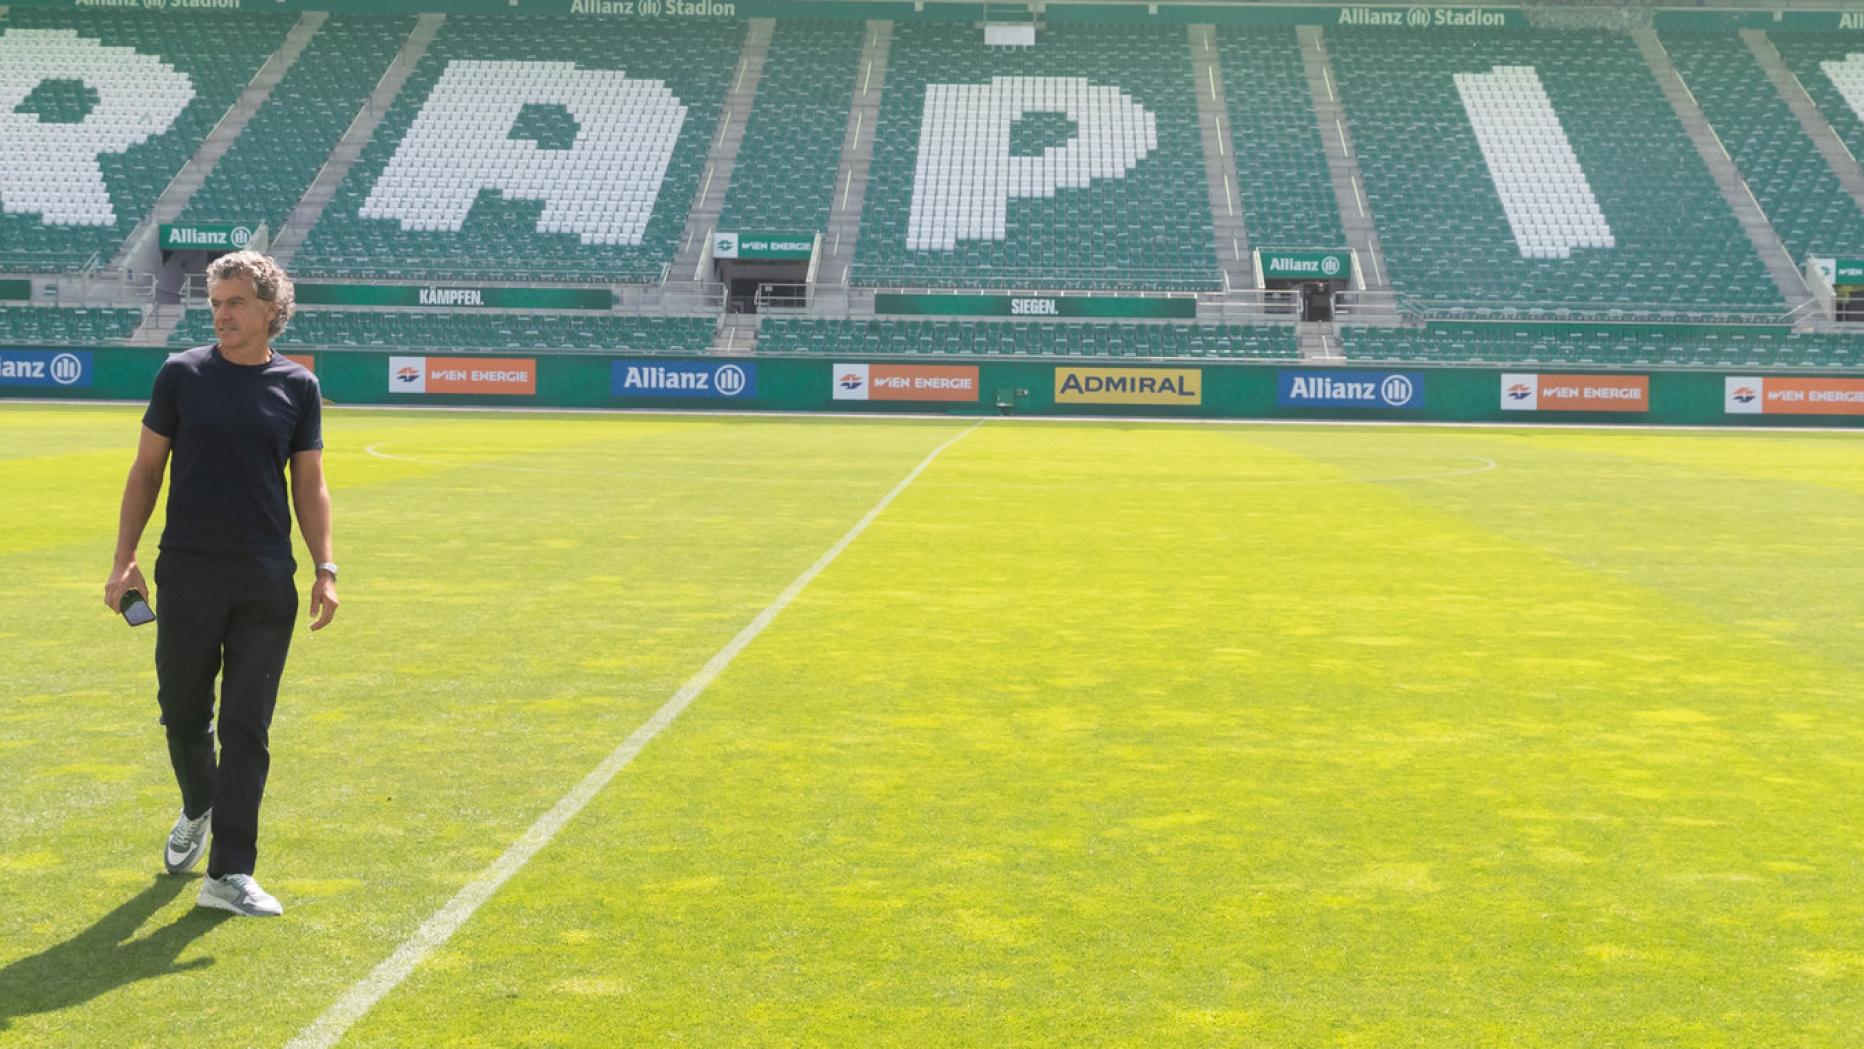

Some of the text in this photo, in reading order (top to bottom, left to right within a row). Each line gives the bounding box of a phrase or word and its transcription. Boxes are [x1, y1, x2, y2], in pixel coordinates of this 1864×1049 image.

[570, 0, 736, 16] Allianz Stadion
[1338, 7, 1505, 27] Allianz Stadion
[168, 228, 228, 244] Allianz
[1270, 257, 1319, 272] Allianz
[419, 286, 485, 306] KÄMPFEN.
[1011, 298, 1059, 315] SIEGEN.
[431, 370, 529, 383] WIEN ENERGIE
[623, 366, 710, 390] Allianz
[874, 376, 973, 390] WIEN ENERGIE
[1059, 373, 1196, 397] ADMIRAL
[1289, 376, 1377, 400] Allianz
[1542, 386, 1643, 400] WIEN ENERGIE
[1767, 389, 1805, 402] WIEN
